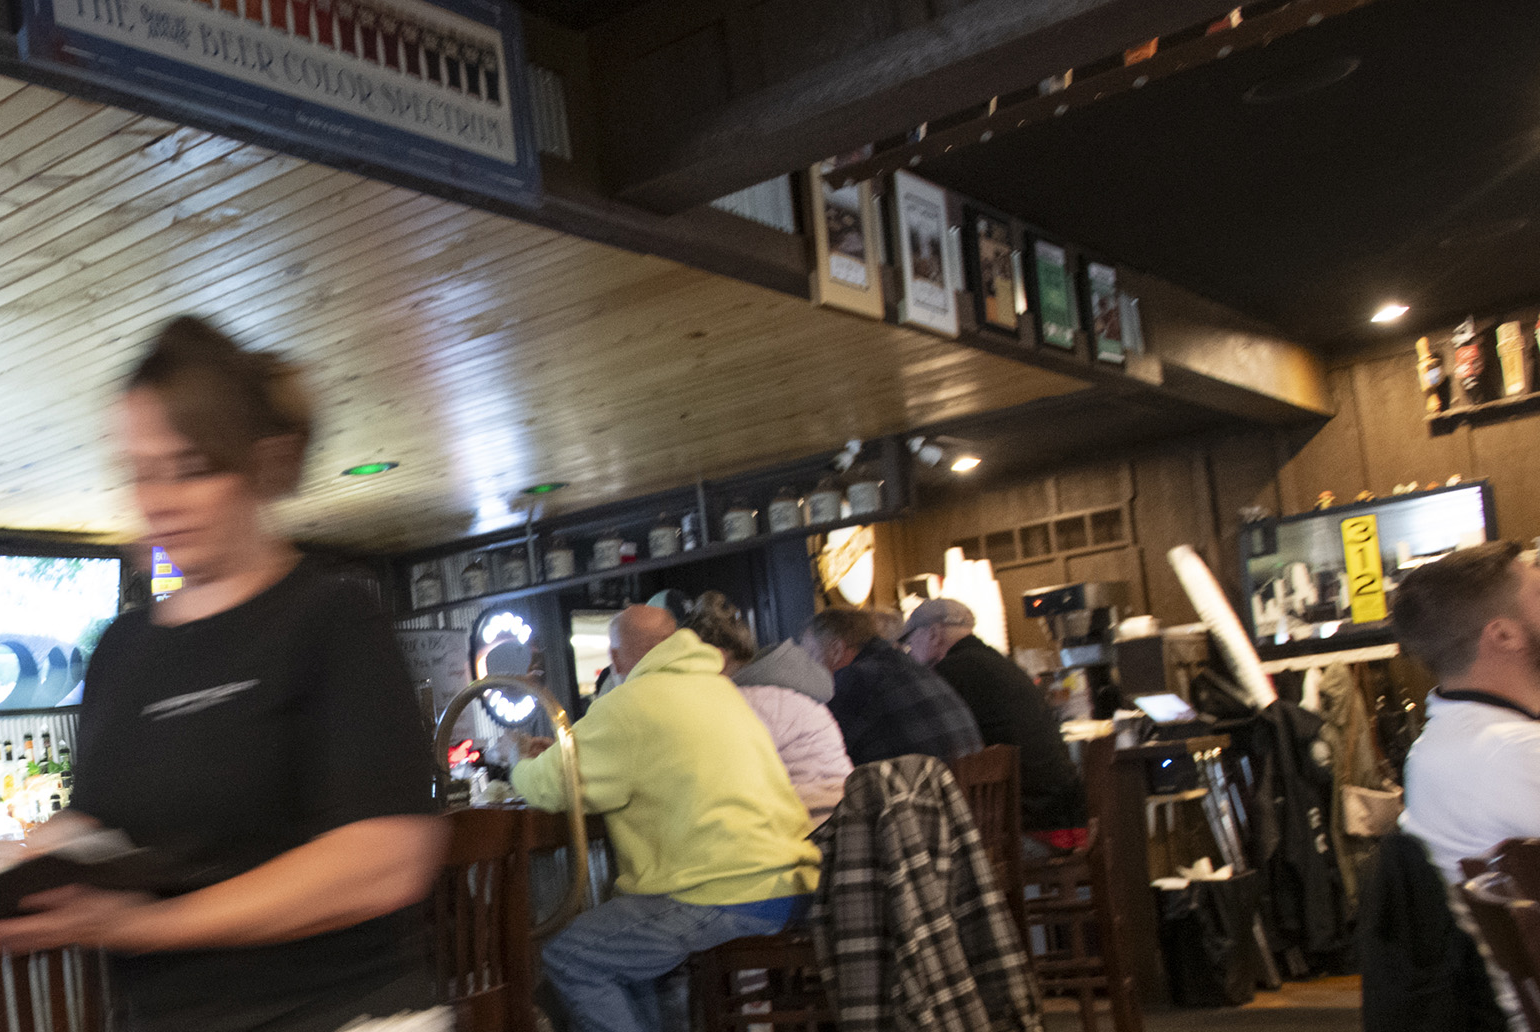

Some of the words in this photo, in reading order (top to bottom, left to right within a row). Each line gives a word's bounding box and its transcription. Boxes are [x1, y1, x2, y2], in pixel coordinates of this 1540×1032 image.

[197, 21, 279, 79] BEER
[282, 50, 377, 112] COLOR
[378, 83, 504, 150] SPECTRUM
